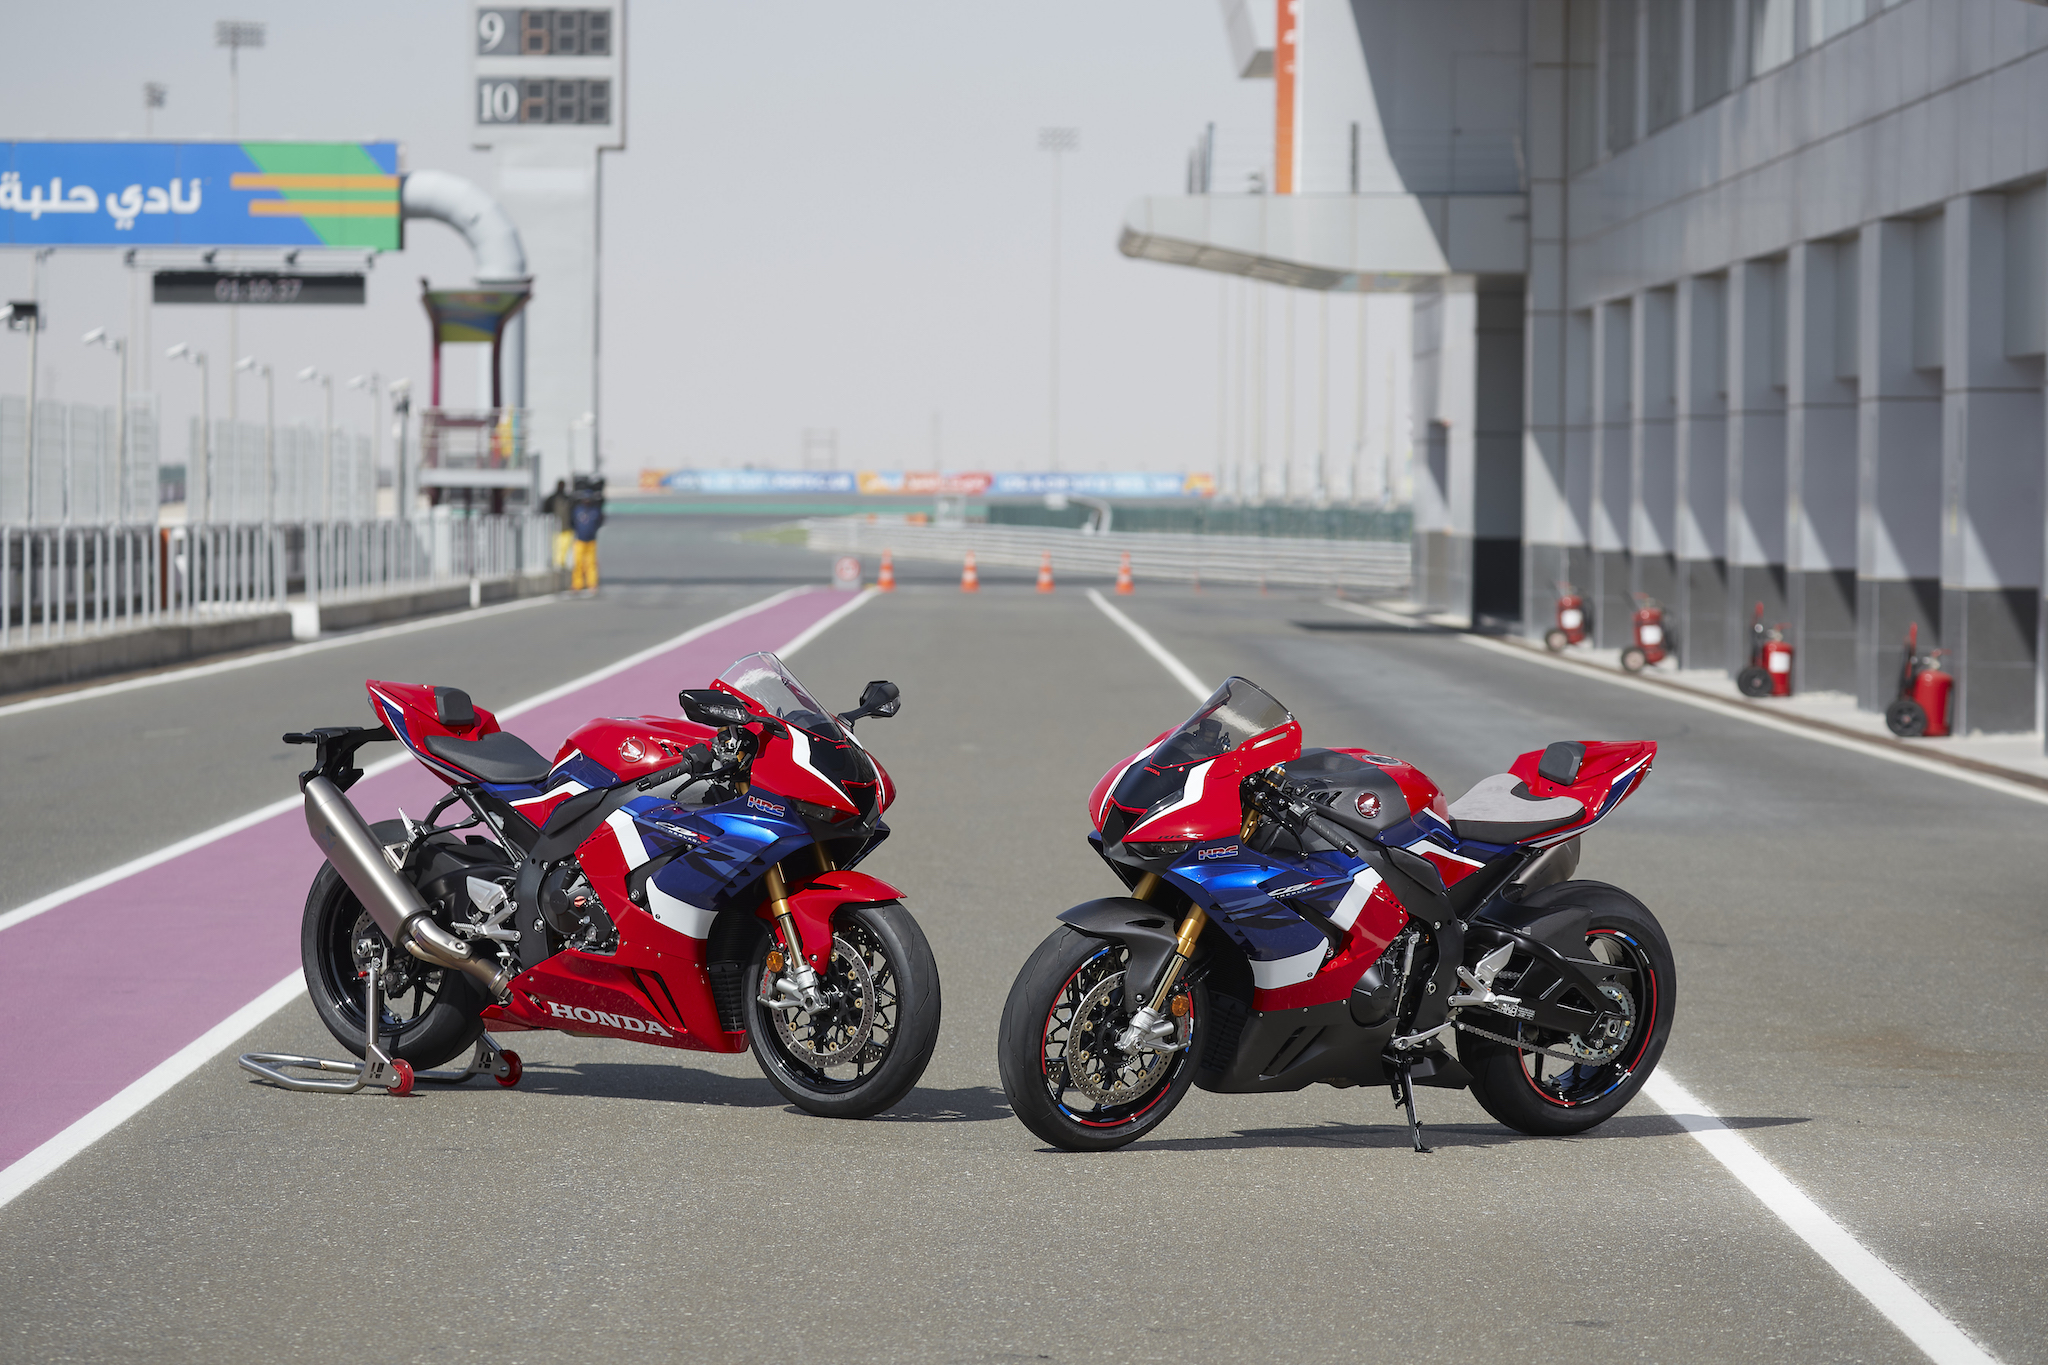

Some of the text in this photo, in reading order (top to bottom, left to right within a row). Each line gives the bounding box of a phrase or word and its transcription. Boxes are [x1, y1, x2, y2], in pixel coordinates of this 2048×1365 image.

[479, 11, 505, 53] 9
[480, 82, 519, 122] 10
[0, 171, 202, 231] نادي حلبة
[747, 795, 785, 817] HRC
[1198, 845, 1239, 860] HRC
[1267, 878, 1327, 896] CBR
[547, 1001, 673, 1038] HONDA
